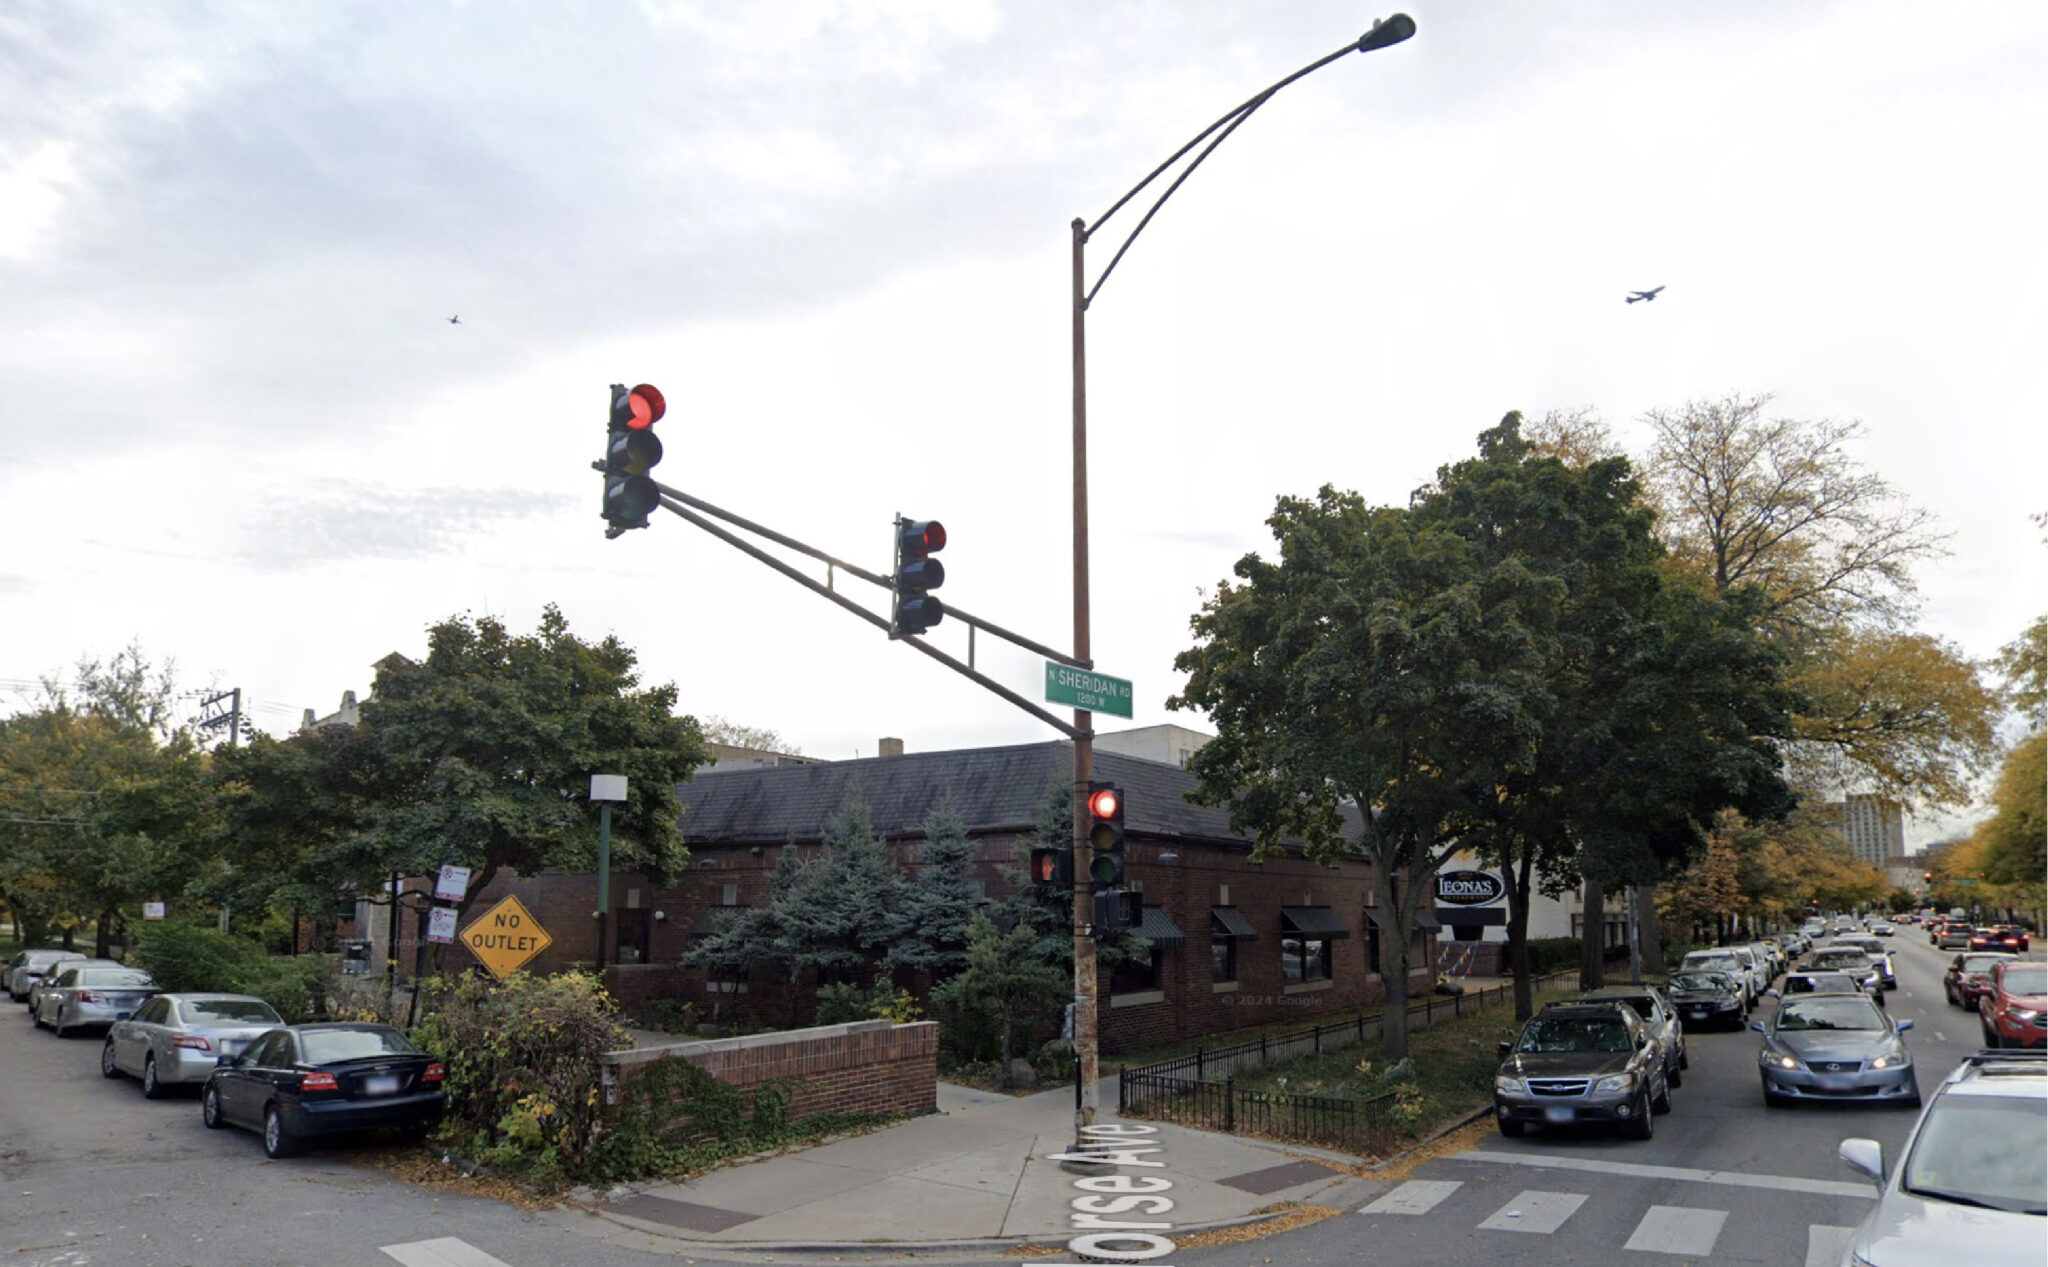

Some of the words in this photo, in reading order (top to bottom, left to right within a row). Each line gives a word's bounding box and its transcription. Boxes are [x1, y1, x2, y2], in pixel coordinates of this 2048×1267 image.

[1049, 669, 1055, 681] N
[1058, 670, 1117, 697] SHERIDAN
[1120, 686, 1130, 698] RD
[1077, 691, 1096, 706] 1200
[1098, 696, 1105, 707] W
[495, 914, 520, 928] NO
[472, 934, 538, 951] OUTLET
